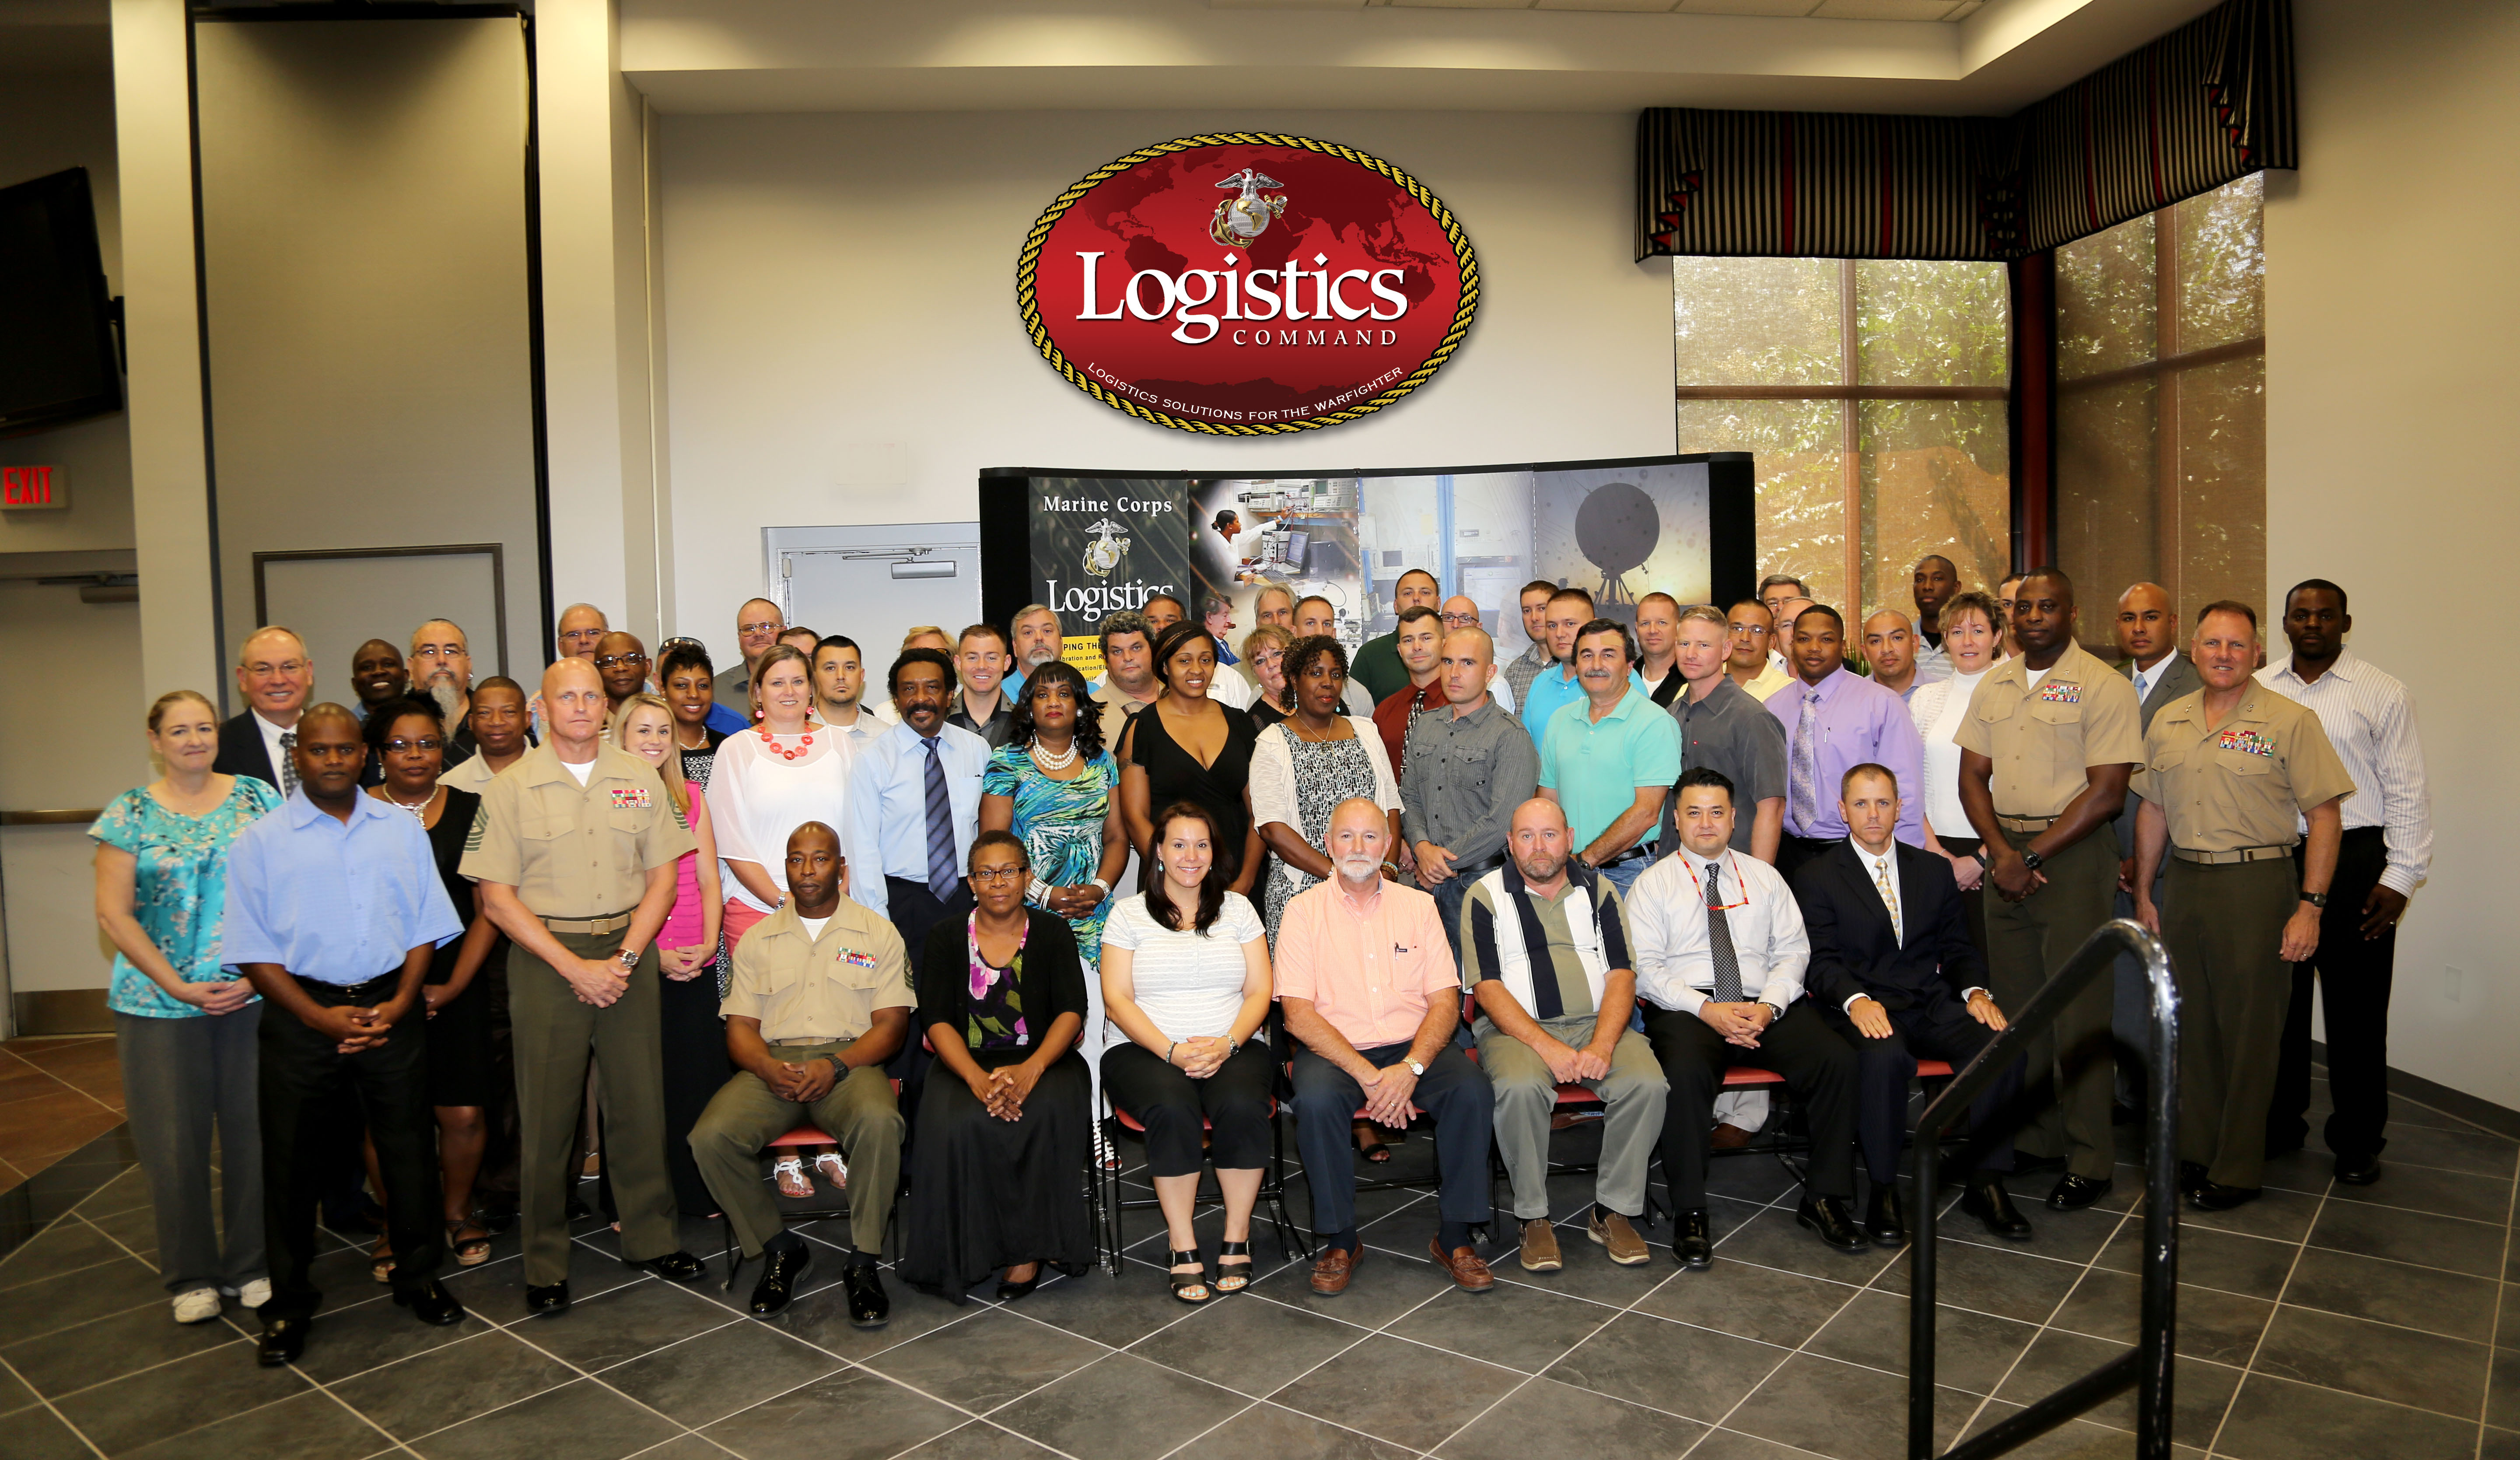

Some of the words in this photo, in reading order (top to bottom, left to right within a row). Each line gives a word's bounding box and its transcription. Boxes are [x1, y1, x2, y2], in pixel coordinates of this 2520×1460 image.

[1076, 251, 1407, 344] Logistics
[1233, 330, 1396, 345] COMMAND
[1088, 362, 1158, 404] LOGISTICS
[1162, 399, 1242, 420] SOLUTIONS
[1249, 411, 1278, 420] FOR
[1281, 406, 1310, 418] THE
[1314, 367, 1403, 412] WARFIGHTER
[3, 467, 52, 504] EXIT
[1043, 496, 1109, 512] Marine
[1117, 497, 1172, 517] Corps
